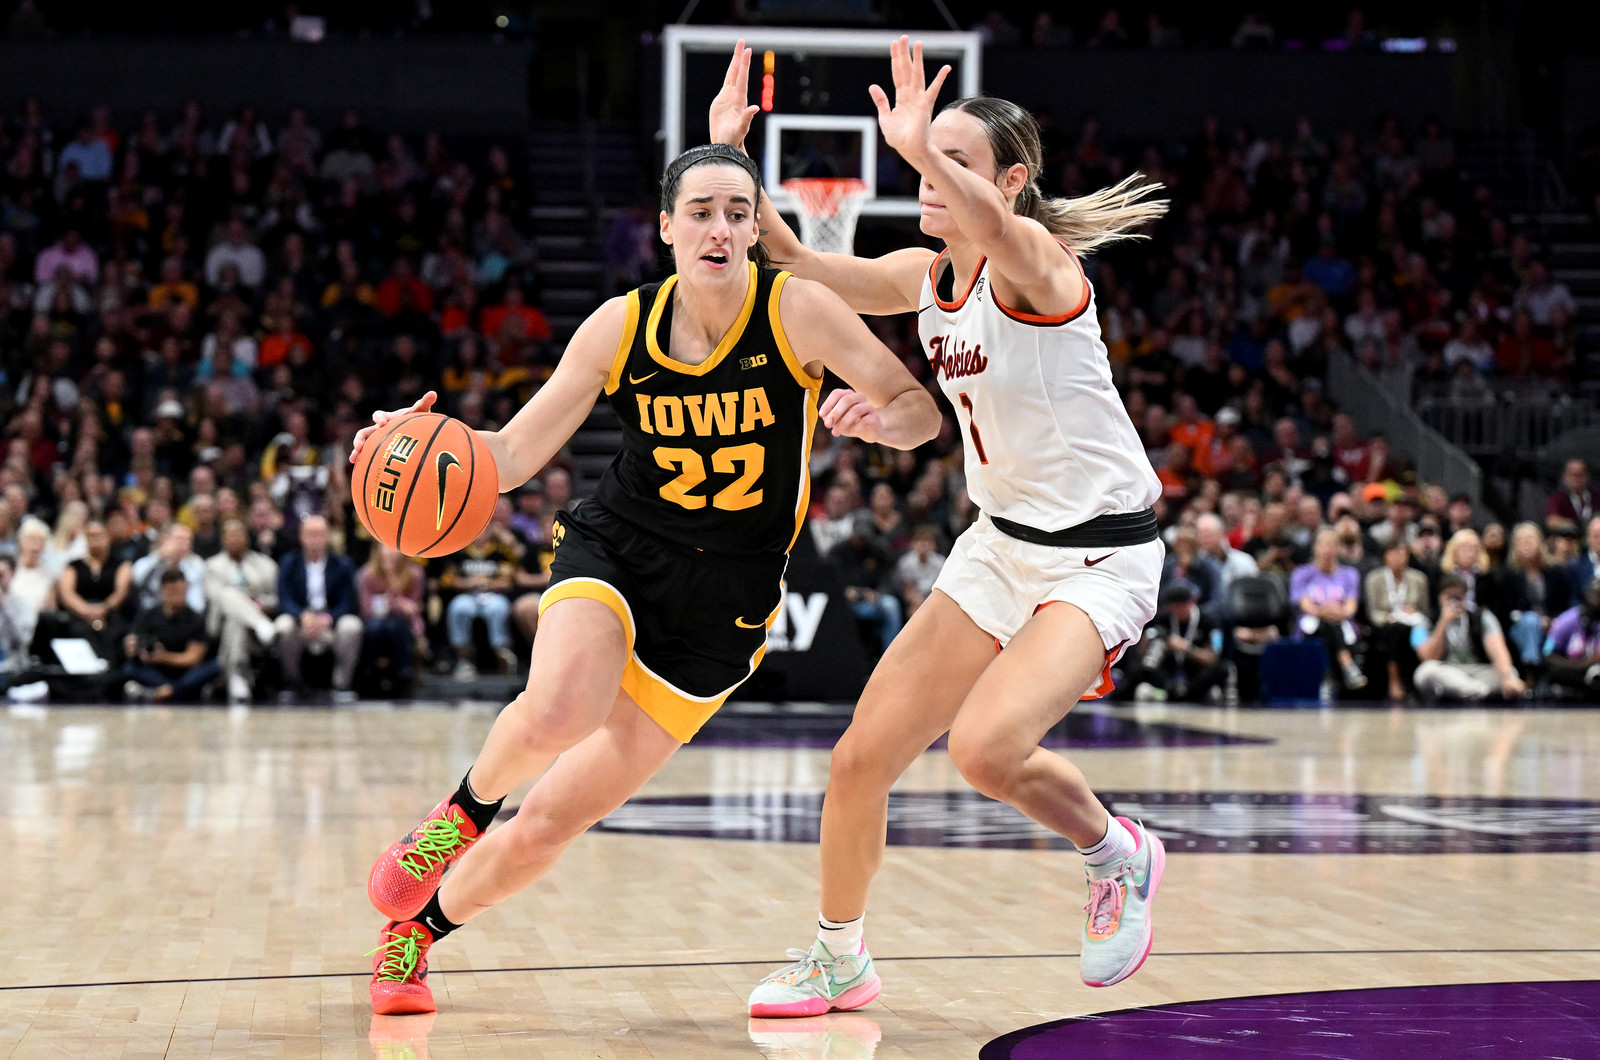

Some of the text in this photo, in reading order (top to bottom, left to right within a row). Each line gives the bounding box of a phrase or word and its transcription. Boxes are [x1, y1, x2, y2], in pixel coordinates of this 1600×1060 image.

[635, 386, 776, 437] IOWA
[959, 392, 989, 465] 1
[374, 434, 420, 514] ELITE
[652, 442, 765, 511] 22
